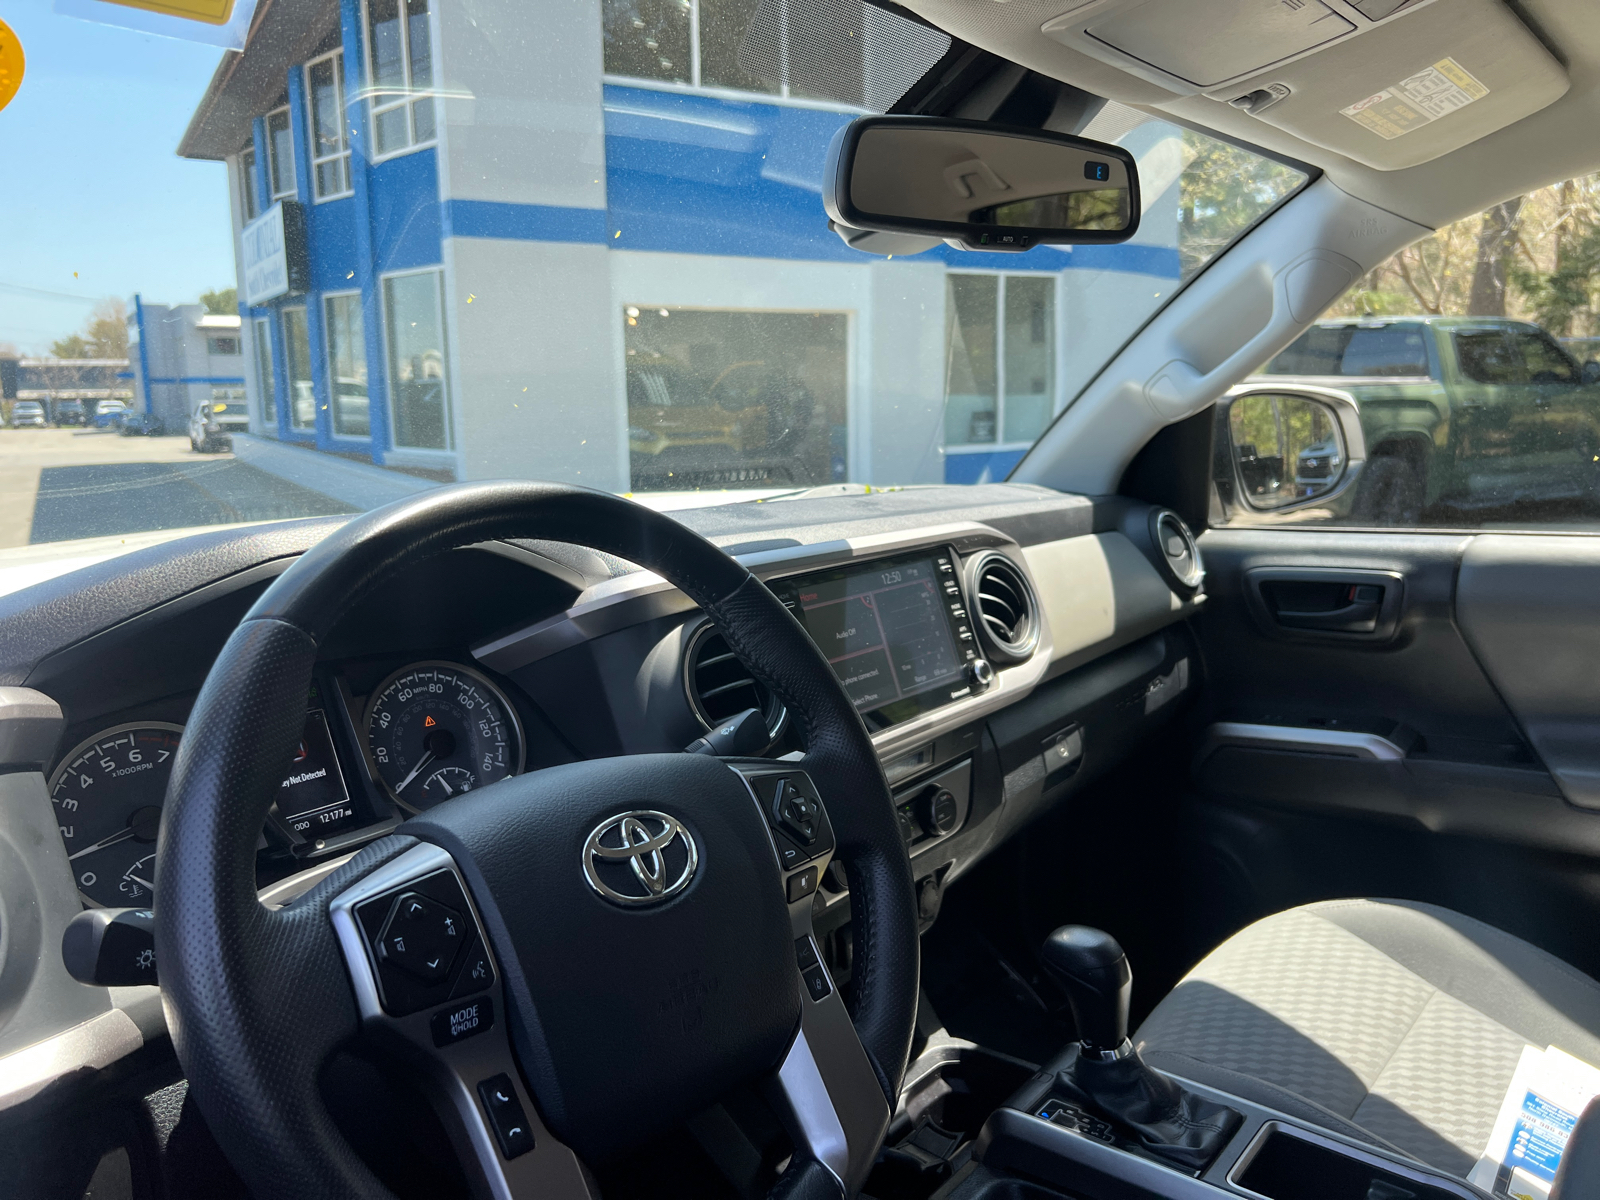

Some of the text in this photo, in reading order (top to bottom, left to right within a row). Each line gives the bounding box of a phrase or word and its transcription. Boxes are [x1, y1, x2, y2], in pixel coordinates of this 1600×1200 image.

[882, 571, 902, 585] 12:50
[799, 593, 818, 603] Home
[836, 628, 857, 640] Audio Off
[845, 677, 858, 686] phone
[858, 669, 880, 680] connected
[399, 689, 413, 702] 60
[413, 686, 428, 694] MPH
[429, 684, 443, 693] 80
[458, 693, 475, 709] 100
[380, 712, 391, 729] 40
[479, 720, 491, 738] 120
[129, 750, 142, 762] 6
[158, 750, 170, 763] 7
[377, 748, 389, 763] 20
[483, 753, 494, 771] 140
[100, 757, 116, 772] 5
[80, 774, 94, 789] 4
[290, 776, 301, 785] Not
[301, 768, 327, 782] Detected
[62, 799, 79, 812] 3
[294, 821, 310, 831] ODO
[320, 809, 344, 823] 12177
[60, 826, 74, 838] 2
[81, 872, 97, 886] 0
[120, 882, 128, 892] C
[451, 1005, 479, 1025] MODE
[458, 1018, 479, 1033] HOLD
